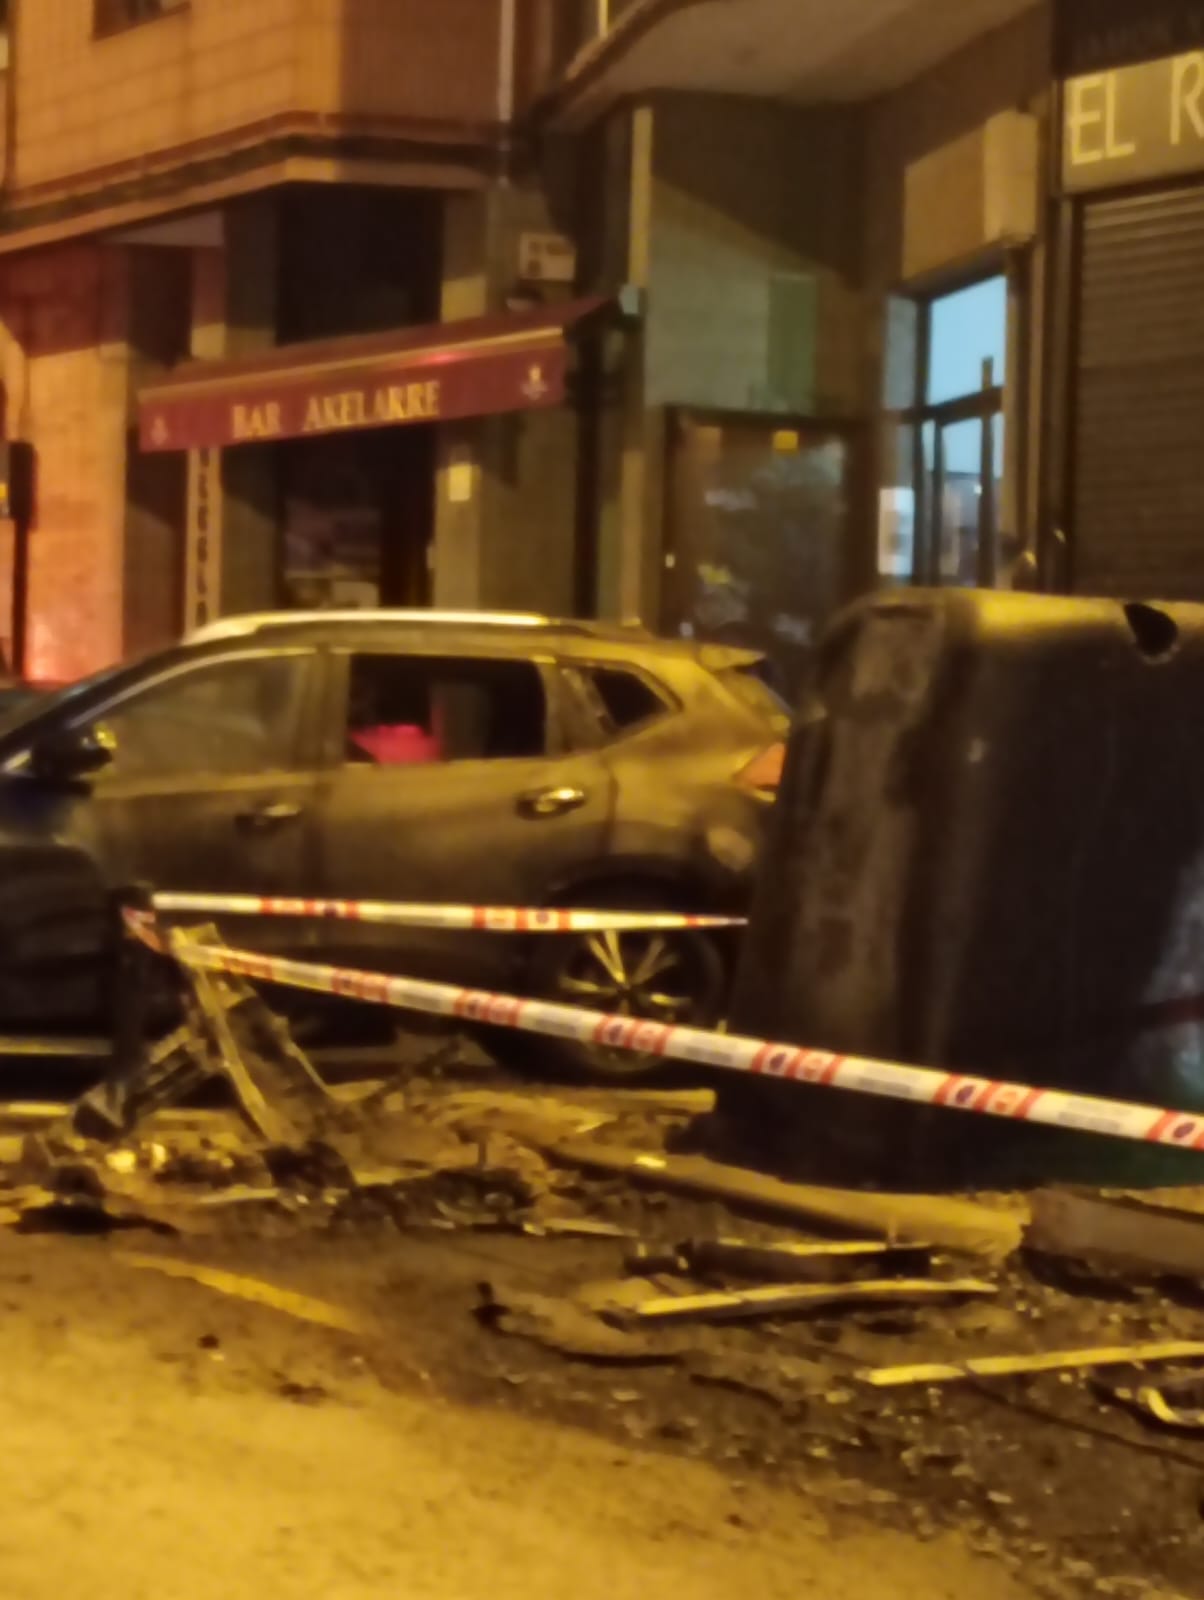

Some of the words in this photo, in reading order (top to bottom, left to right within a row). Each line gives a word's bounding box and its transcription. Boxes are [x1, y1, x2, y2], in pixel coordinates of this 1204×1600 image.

[1070, 72, 1136, 165] EL
[232, 402, 281, 440] BAR
[303, 380, 441, 431] AKELARRE
